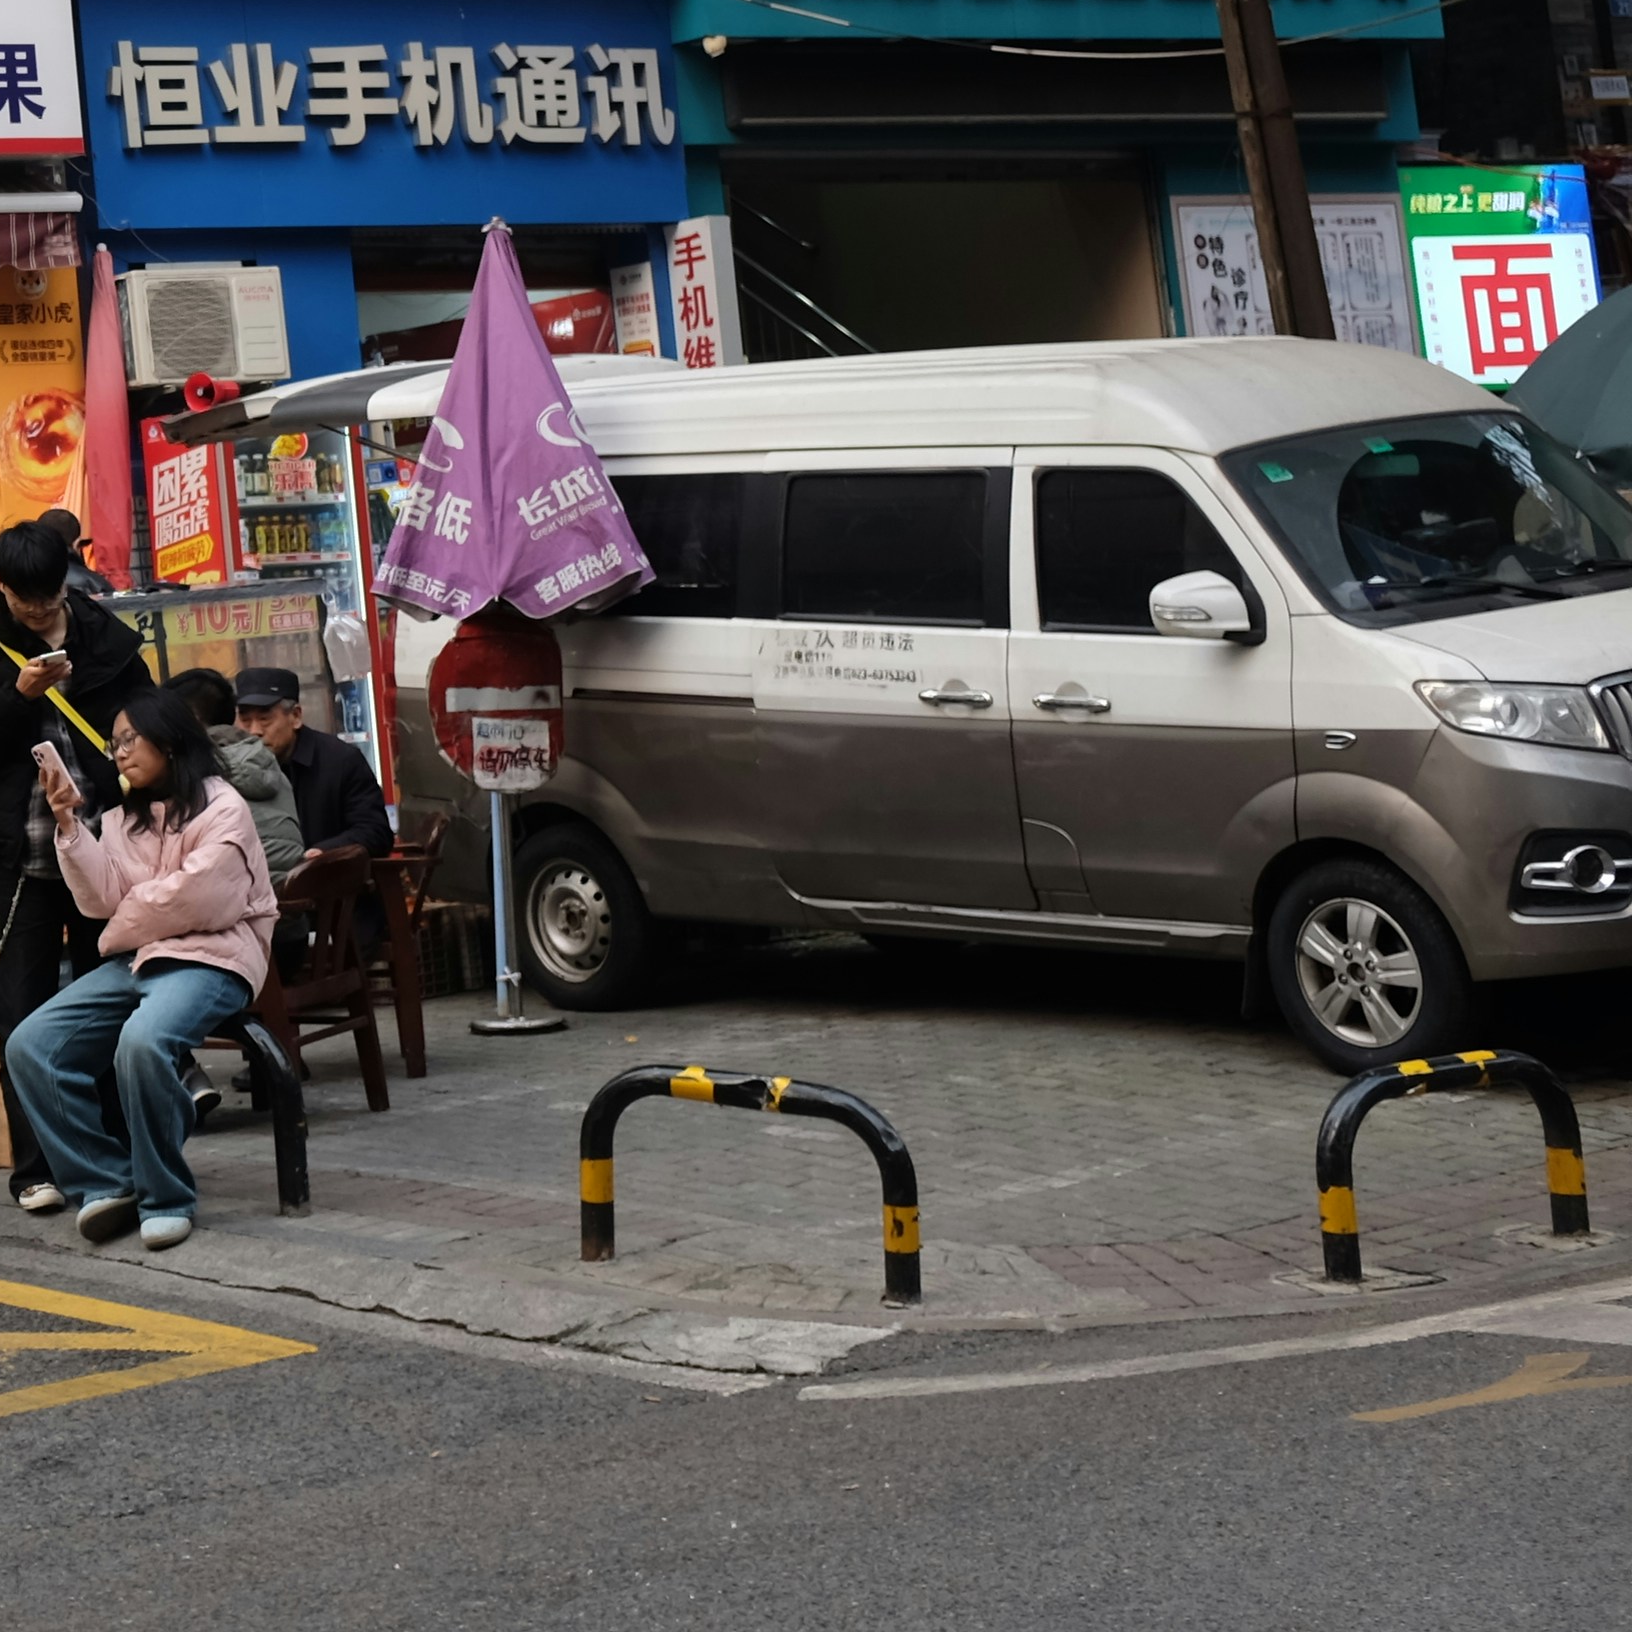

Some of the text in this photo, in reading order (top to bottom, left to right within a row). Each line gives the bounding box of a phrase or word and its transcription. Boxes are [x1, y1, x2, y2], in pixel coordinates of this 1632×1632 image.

[105, 38, 677, 150] 恒业手机通讯
[673, 231, 717, 369] 手机维
[1451, 243, 1564, 376] 面
[534, 542, 623, 605] 客服热线
